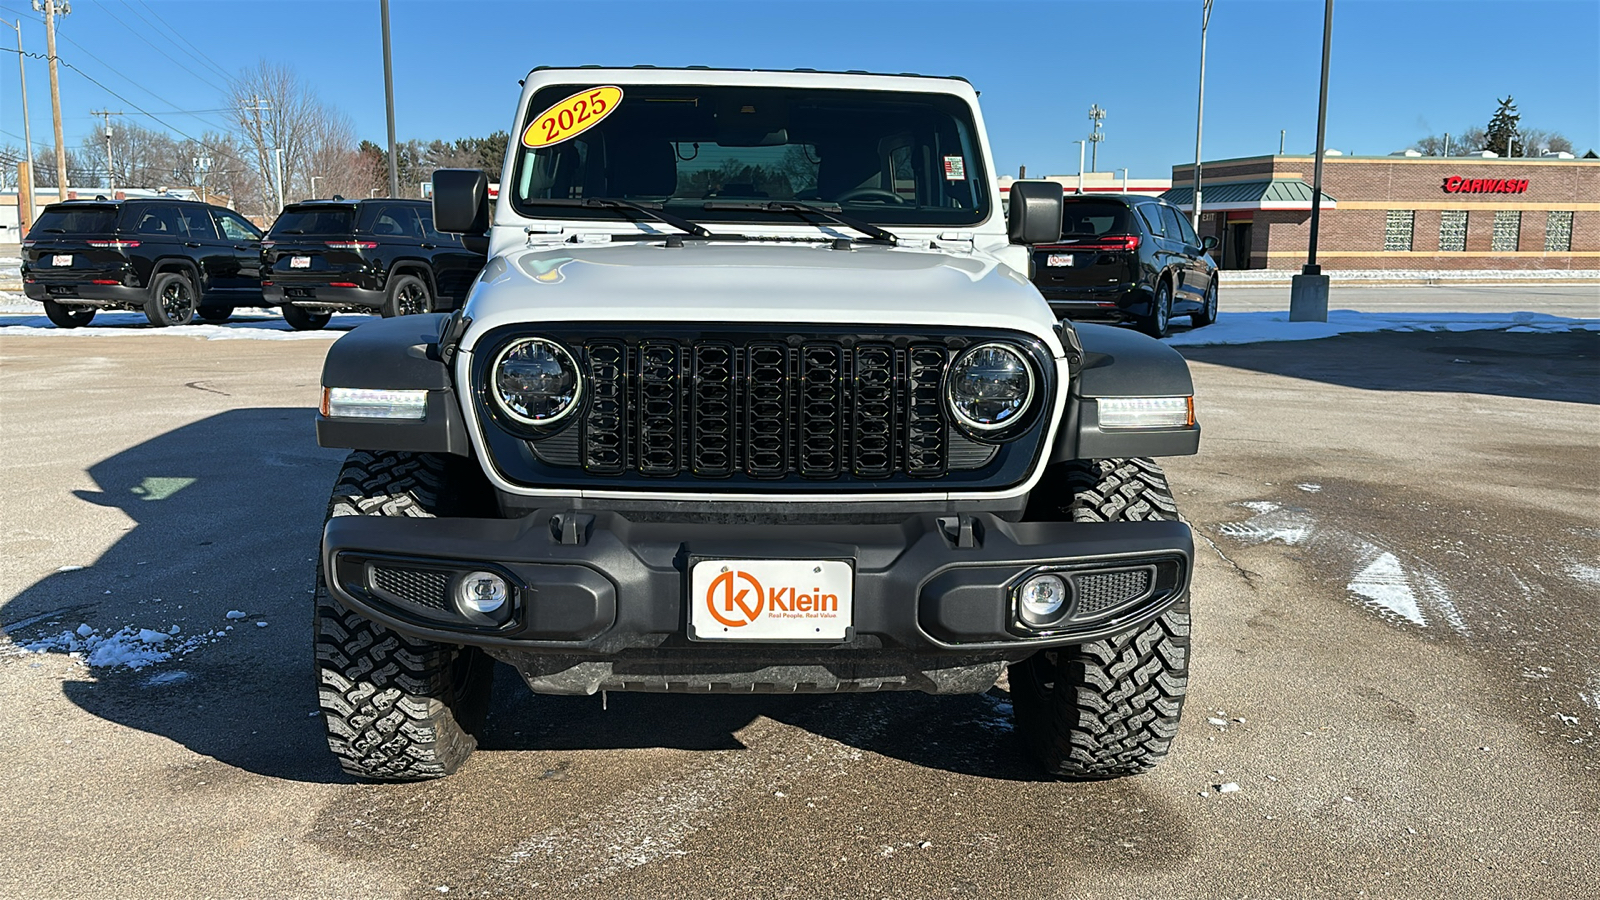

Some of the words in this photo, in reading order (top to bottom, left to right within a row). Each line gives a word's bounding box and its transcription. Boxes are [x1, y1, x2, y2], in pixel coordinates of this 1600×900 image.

[541, 91, 606, 142] 2025
[1445, 175, 1530, 193] CARWASH
[1202, 213, 1215, 222] EXIT
[769, 587, 838, 611] Klein
